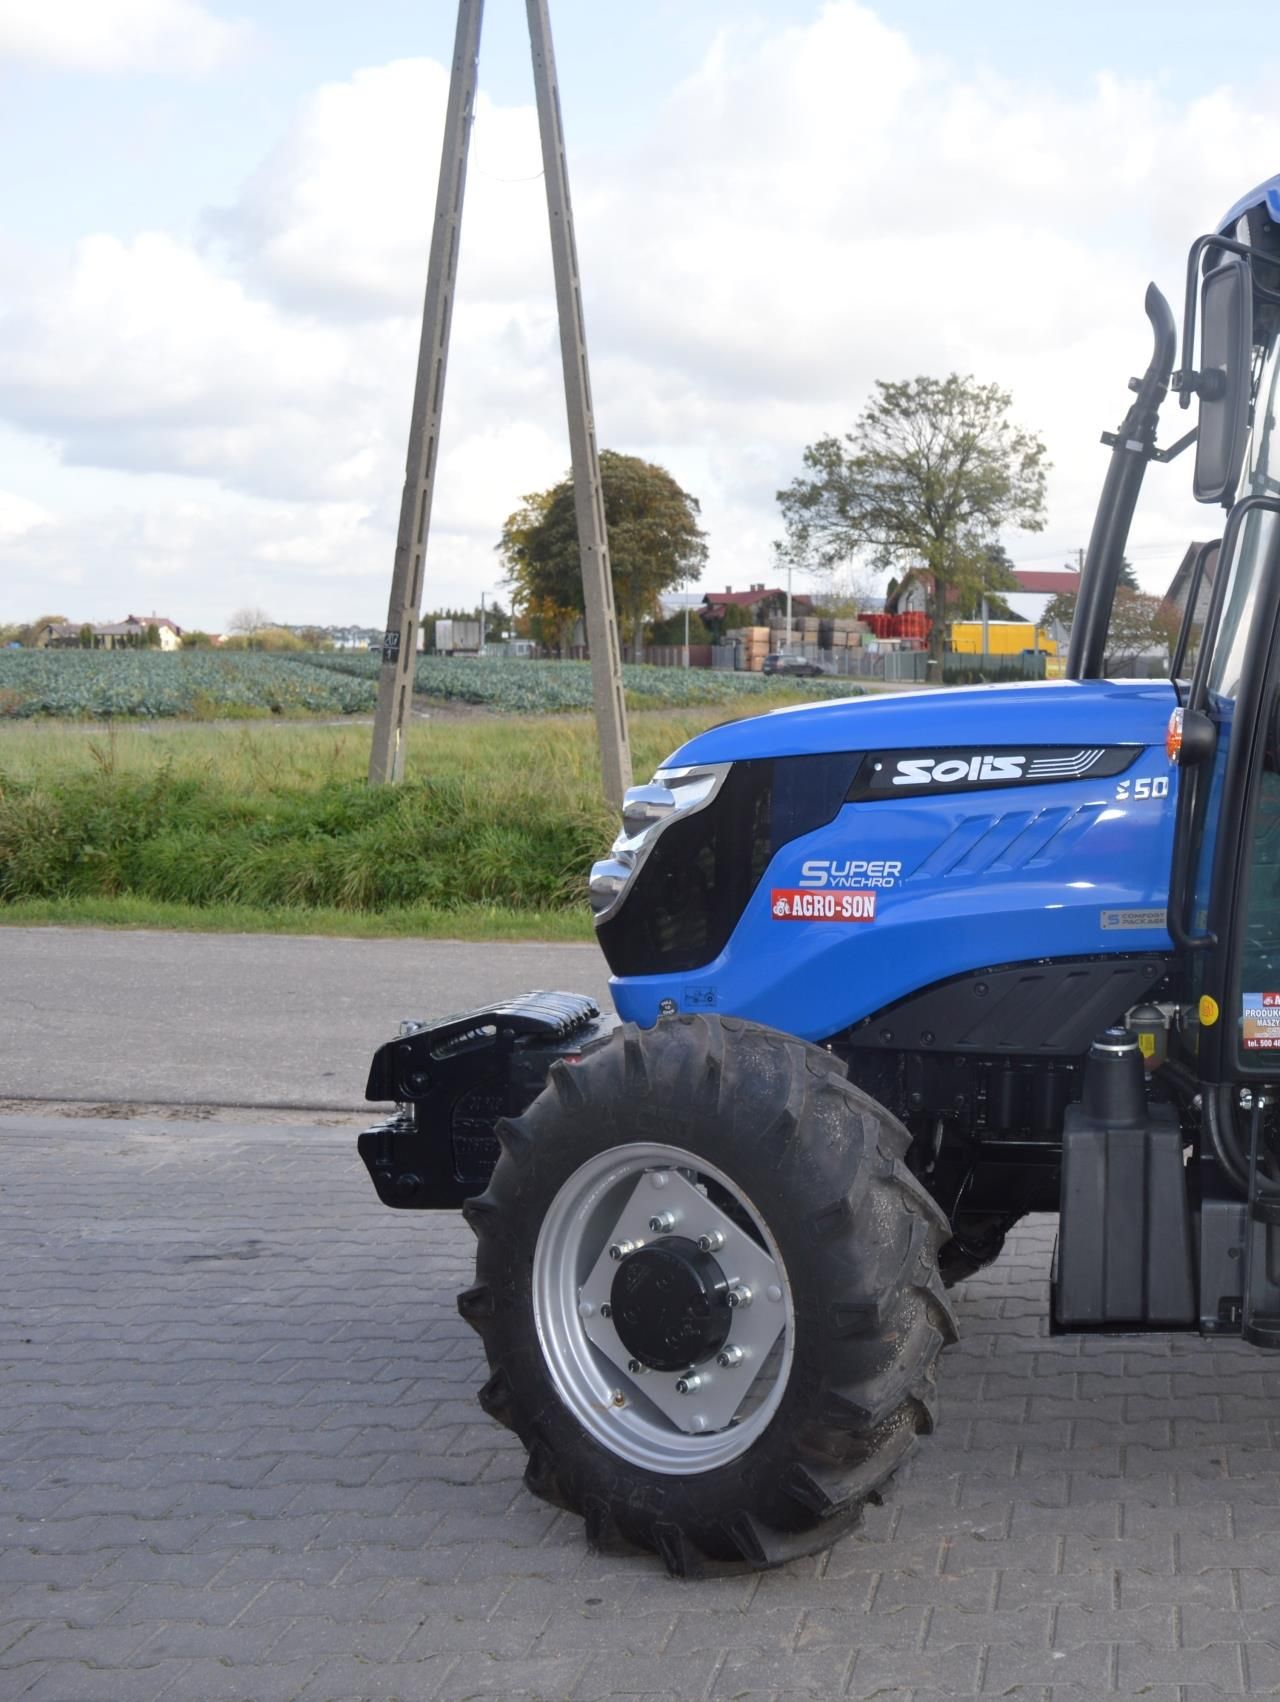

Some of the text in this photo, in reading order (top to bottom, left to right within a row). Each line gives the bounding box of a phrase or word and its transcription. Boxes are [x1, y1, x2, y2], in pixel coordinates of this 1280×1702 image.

[792, 895, 875, 918] AGRO-SON
[1248, 1039, 1259, 1047] tel.
[1260, 1039, 1272, 1047] 500
